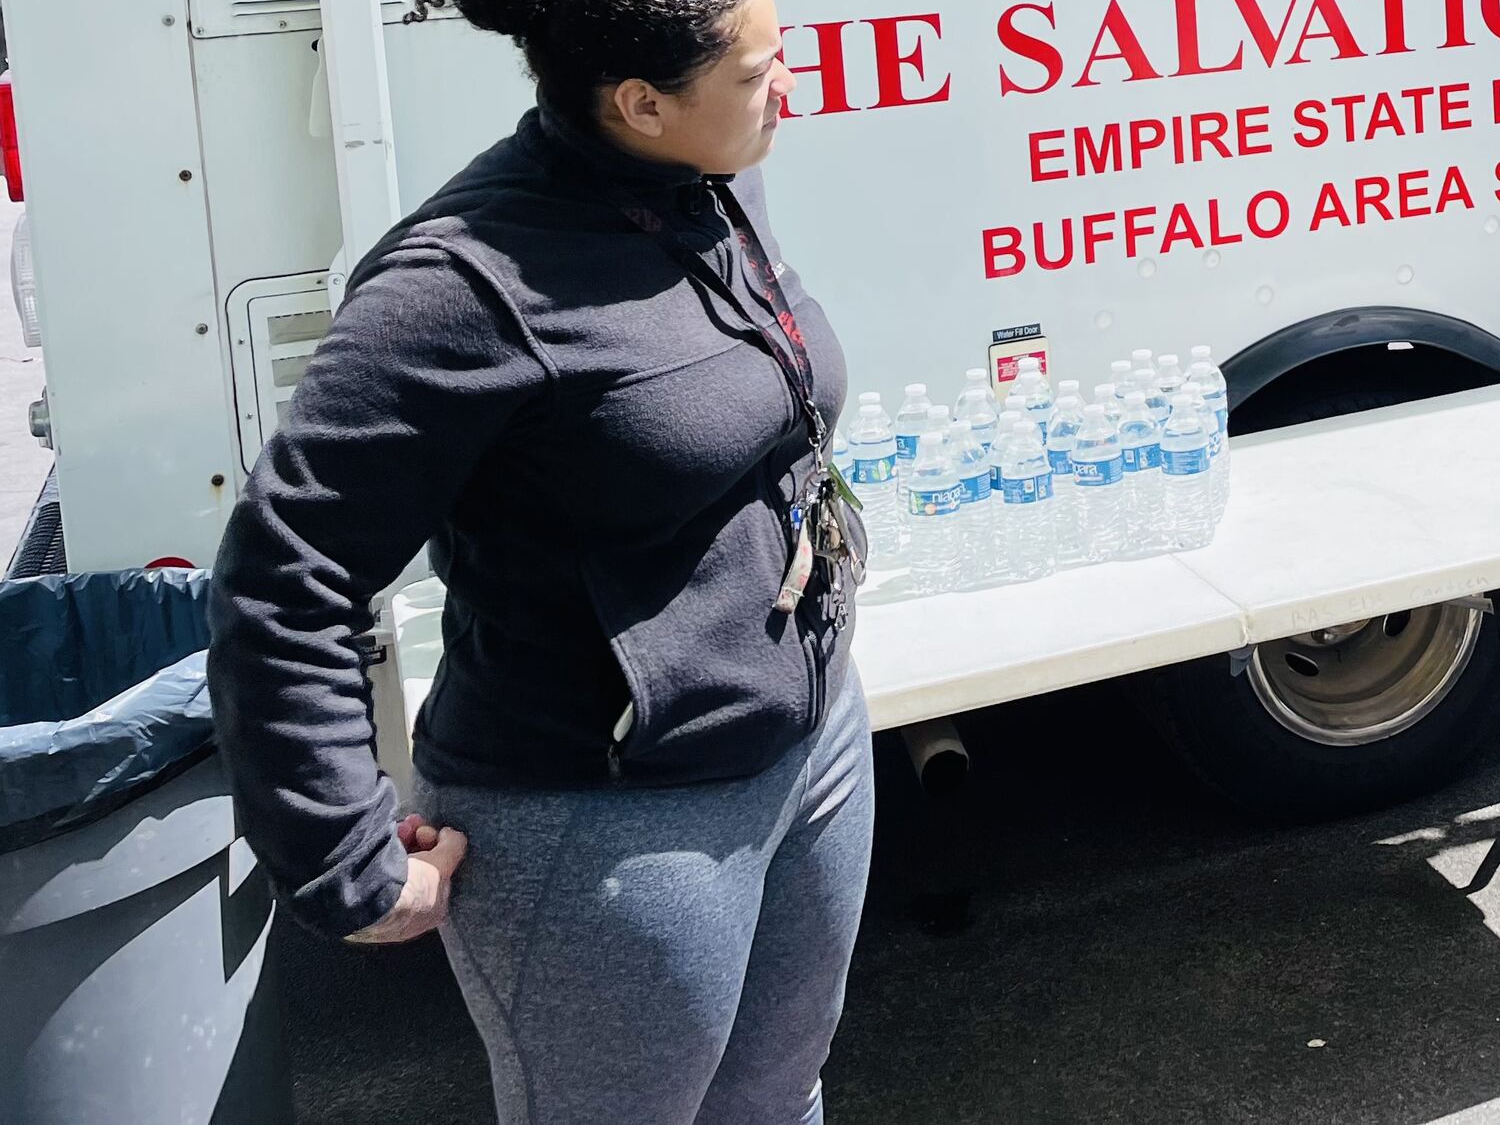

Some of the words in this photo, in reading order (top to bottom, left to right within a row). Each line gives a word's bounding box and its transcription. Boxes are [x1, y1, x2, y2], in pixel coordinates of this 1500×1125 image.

[779, 13, 951, 119] HE
[1029, 106, 1272, 183] EMPIRE
[1293, 83, 1473, 149] STATE
[982, 189, 1289, 280] BUFFALO
[1308, 166, 1475, 233] AREA
